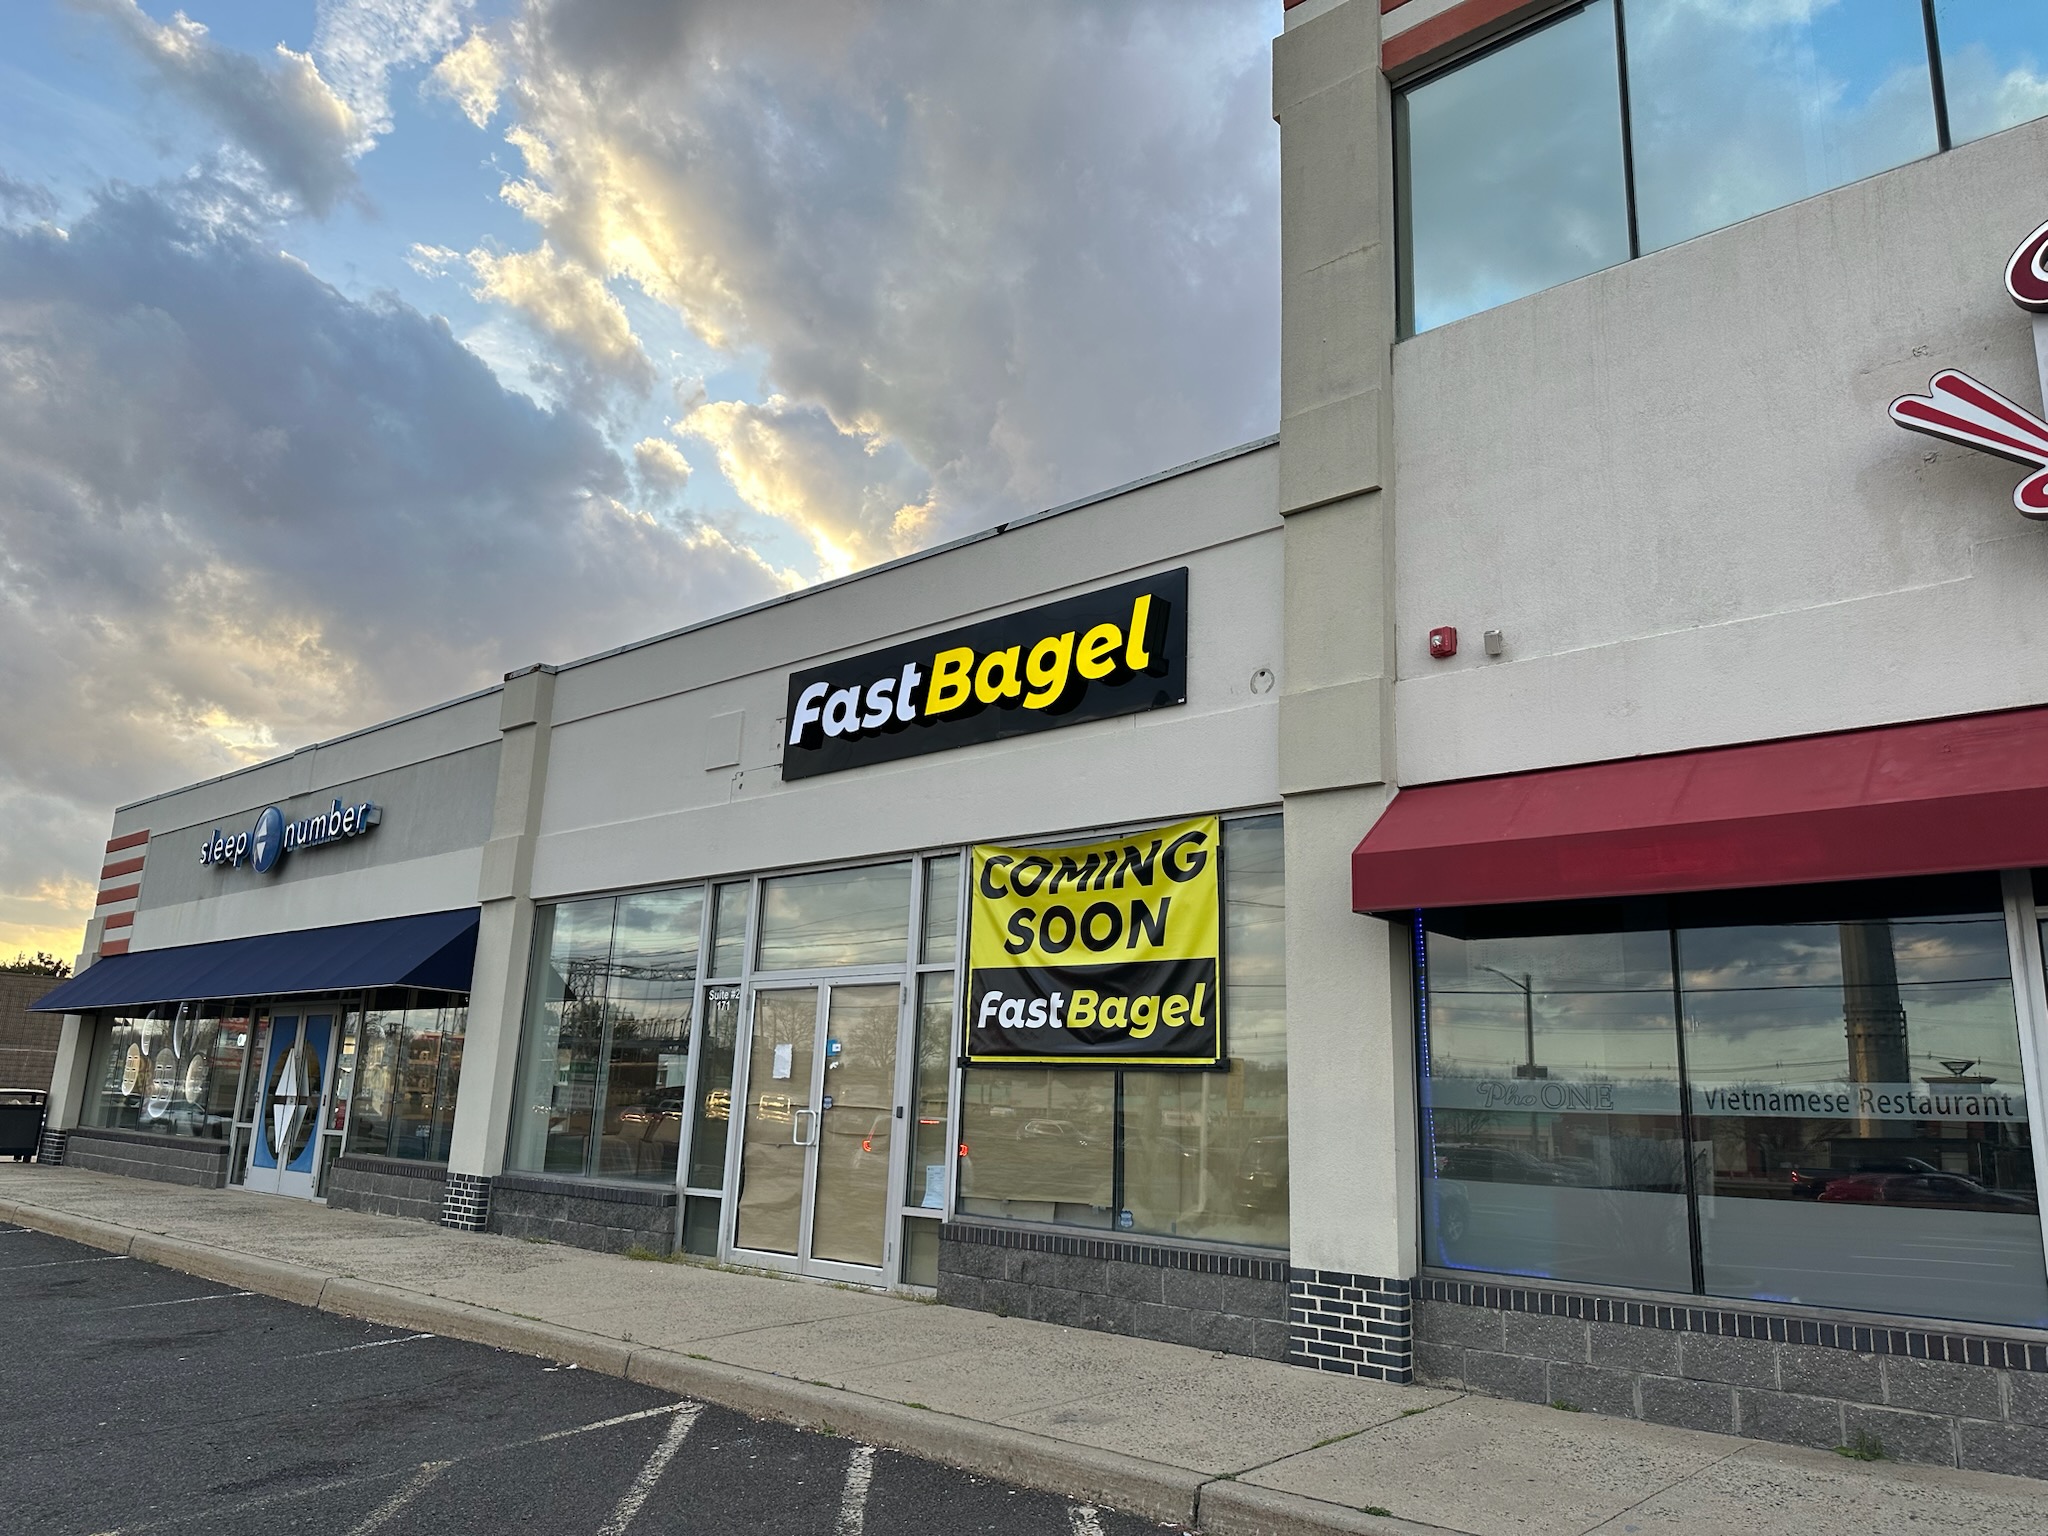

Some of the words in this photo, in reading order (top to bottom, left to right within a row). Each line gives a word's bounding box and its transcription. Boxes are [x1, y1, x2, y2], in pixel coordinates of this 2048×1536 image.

[199, 829, 247, 867] sleep
[283, 799, 367, 848] number
[980, 831, 1208, 899] COMING
[1004, 896, 1171, 955] SOON
[708, 989, 730, 1001] Suite
[716, 1000, 730, 1011] 171
[1476, 1081, 1538, 1109] Pho
[1540, 1082, 1615, 1111] ONE
[1702, 1087, 1850, 1113] Vietnamese
[1858, 1087, 2015, 1117] Restaurant
